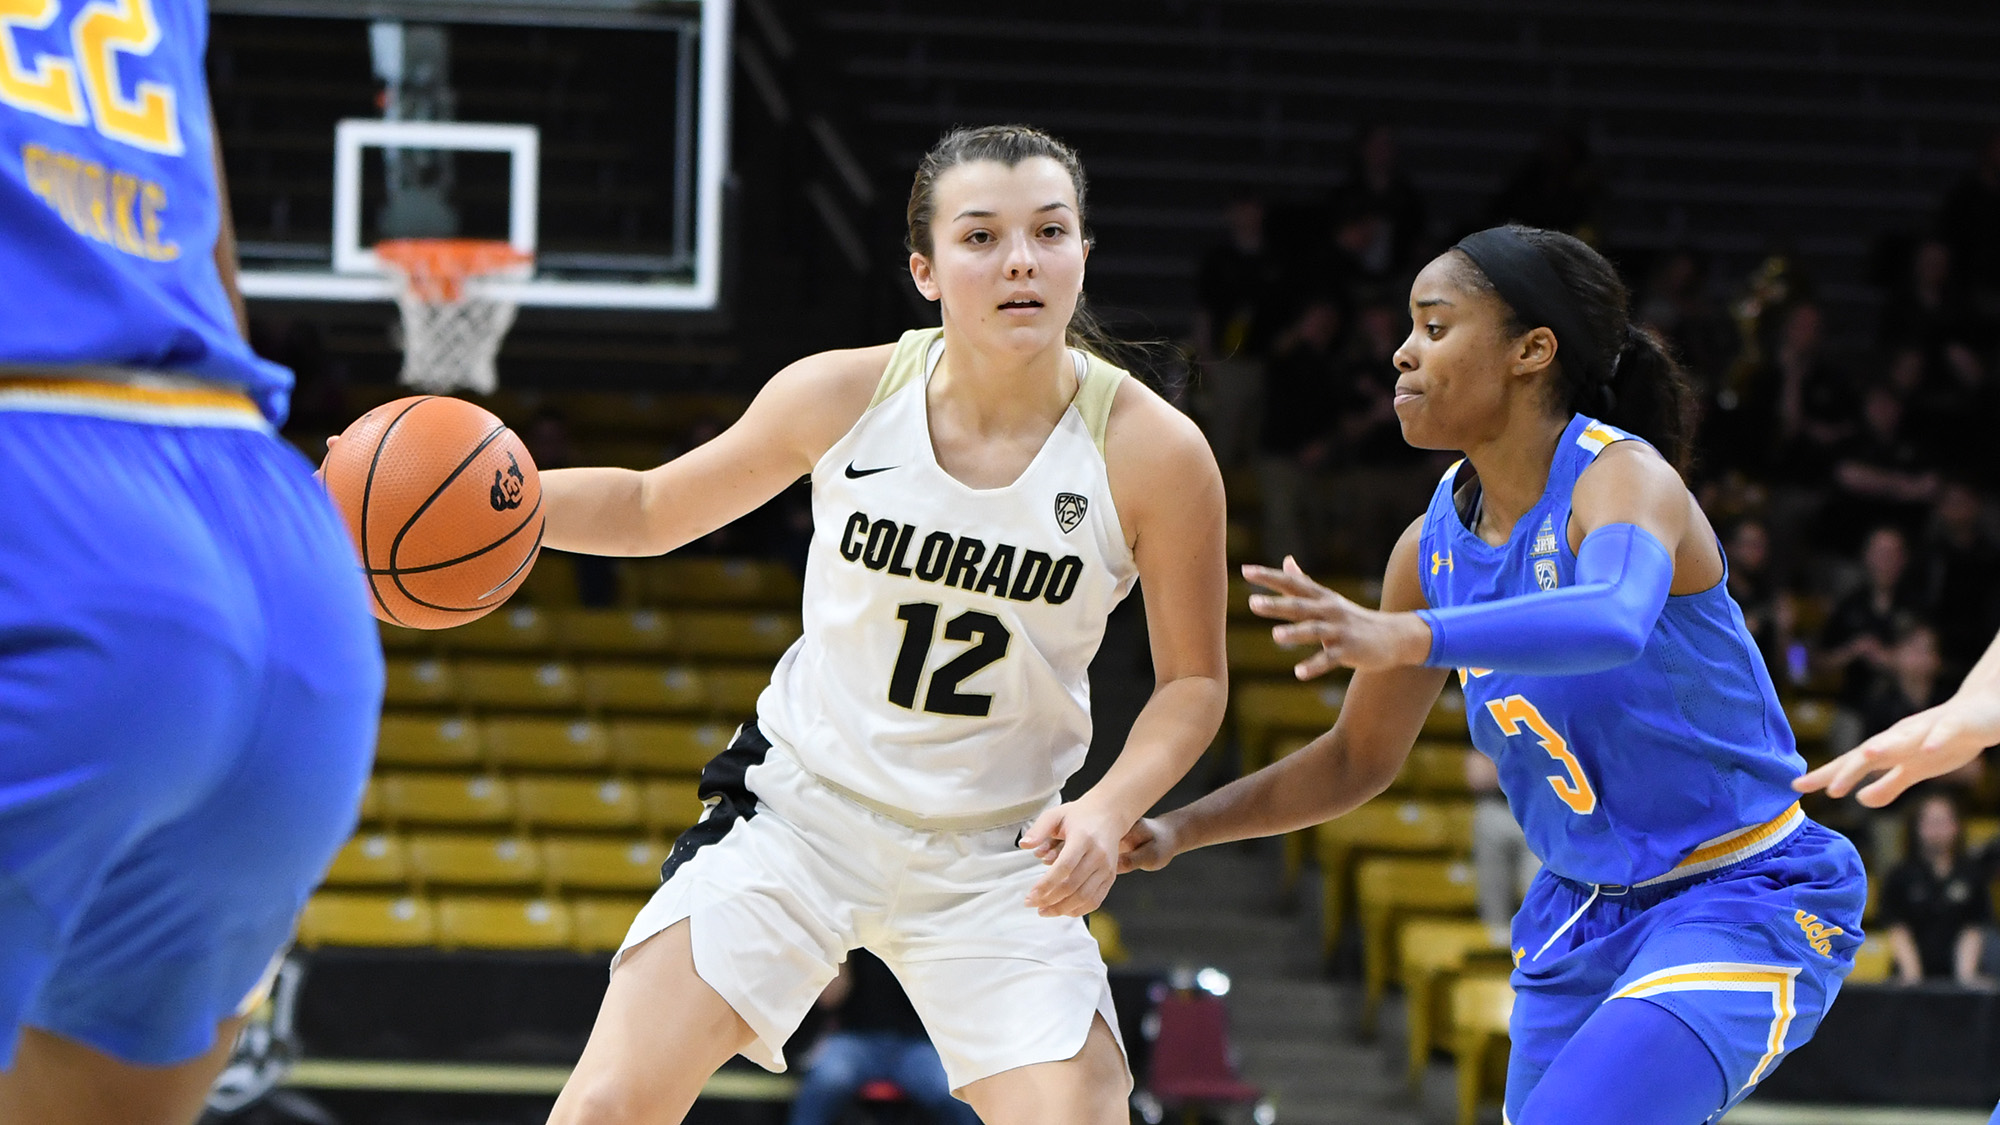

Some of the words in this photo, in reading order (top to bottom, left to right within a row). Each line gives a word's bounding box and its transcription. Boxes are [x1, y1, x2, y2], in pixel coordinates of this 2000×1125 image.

[1057, 495, 1086, 518] PAC
[1061, 510, 1077, 525] 12
[840, 511, 1084, 605] COLORADO
[888, 600, 1014, 718] 12
[1485, 694, 1596, 815] 3
